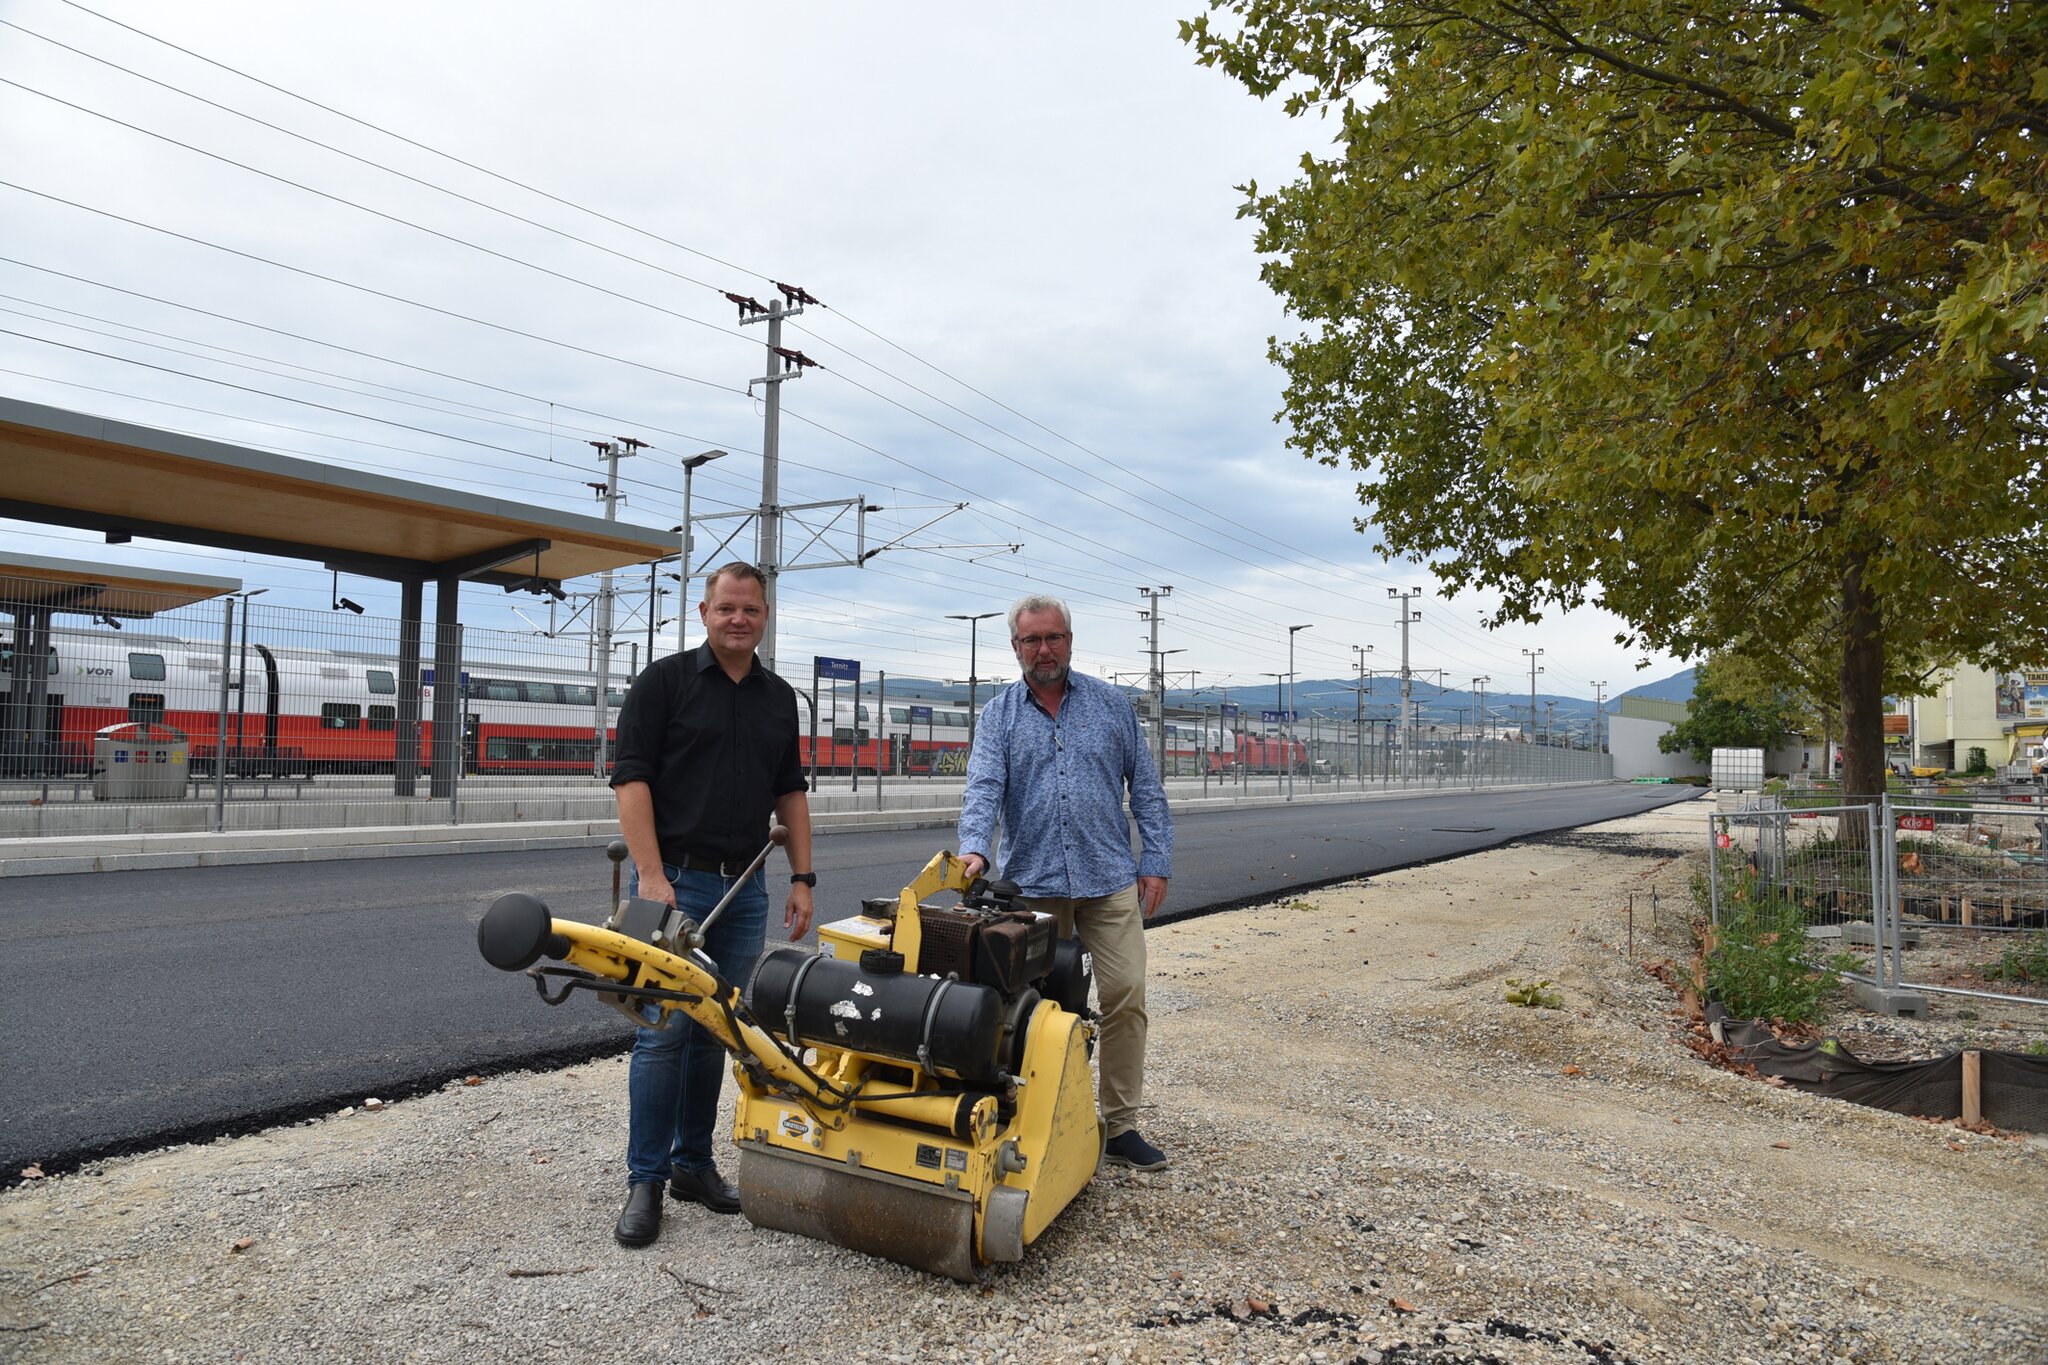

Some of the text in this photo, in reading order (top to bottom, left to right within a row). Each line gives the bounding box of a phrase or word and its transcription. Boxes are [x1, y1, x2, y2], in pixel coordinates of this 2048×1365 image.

[831, 661, 849, 670] Ternitz
[87, 667, 114, 676] VOR
[1264, 713, 1270, 721] 2
